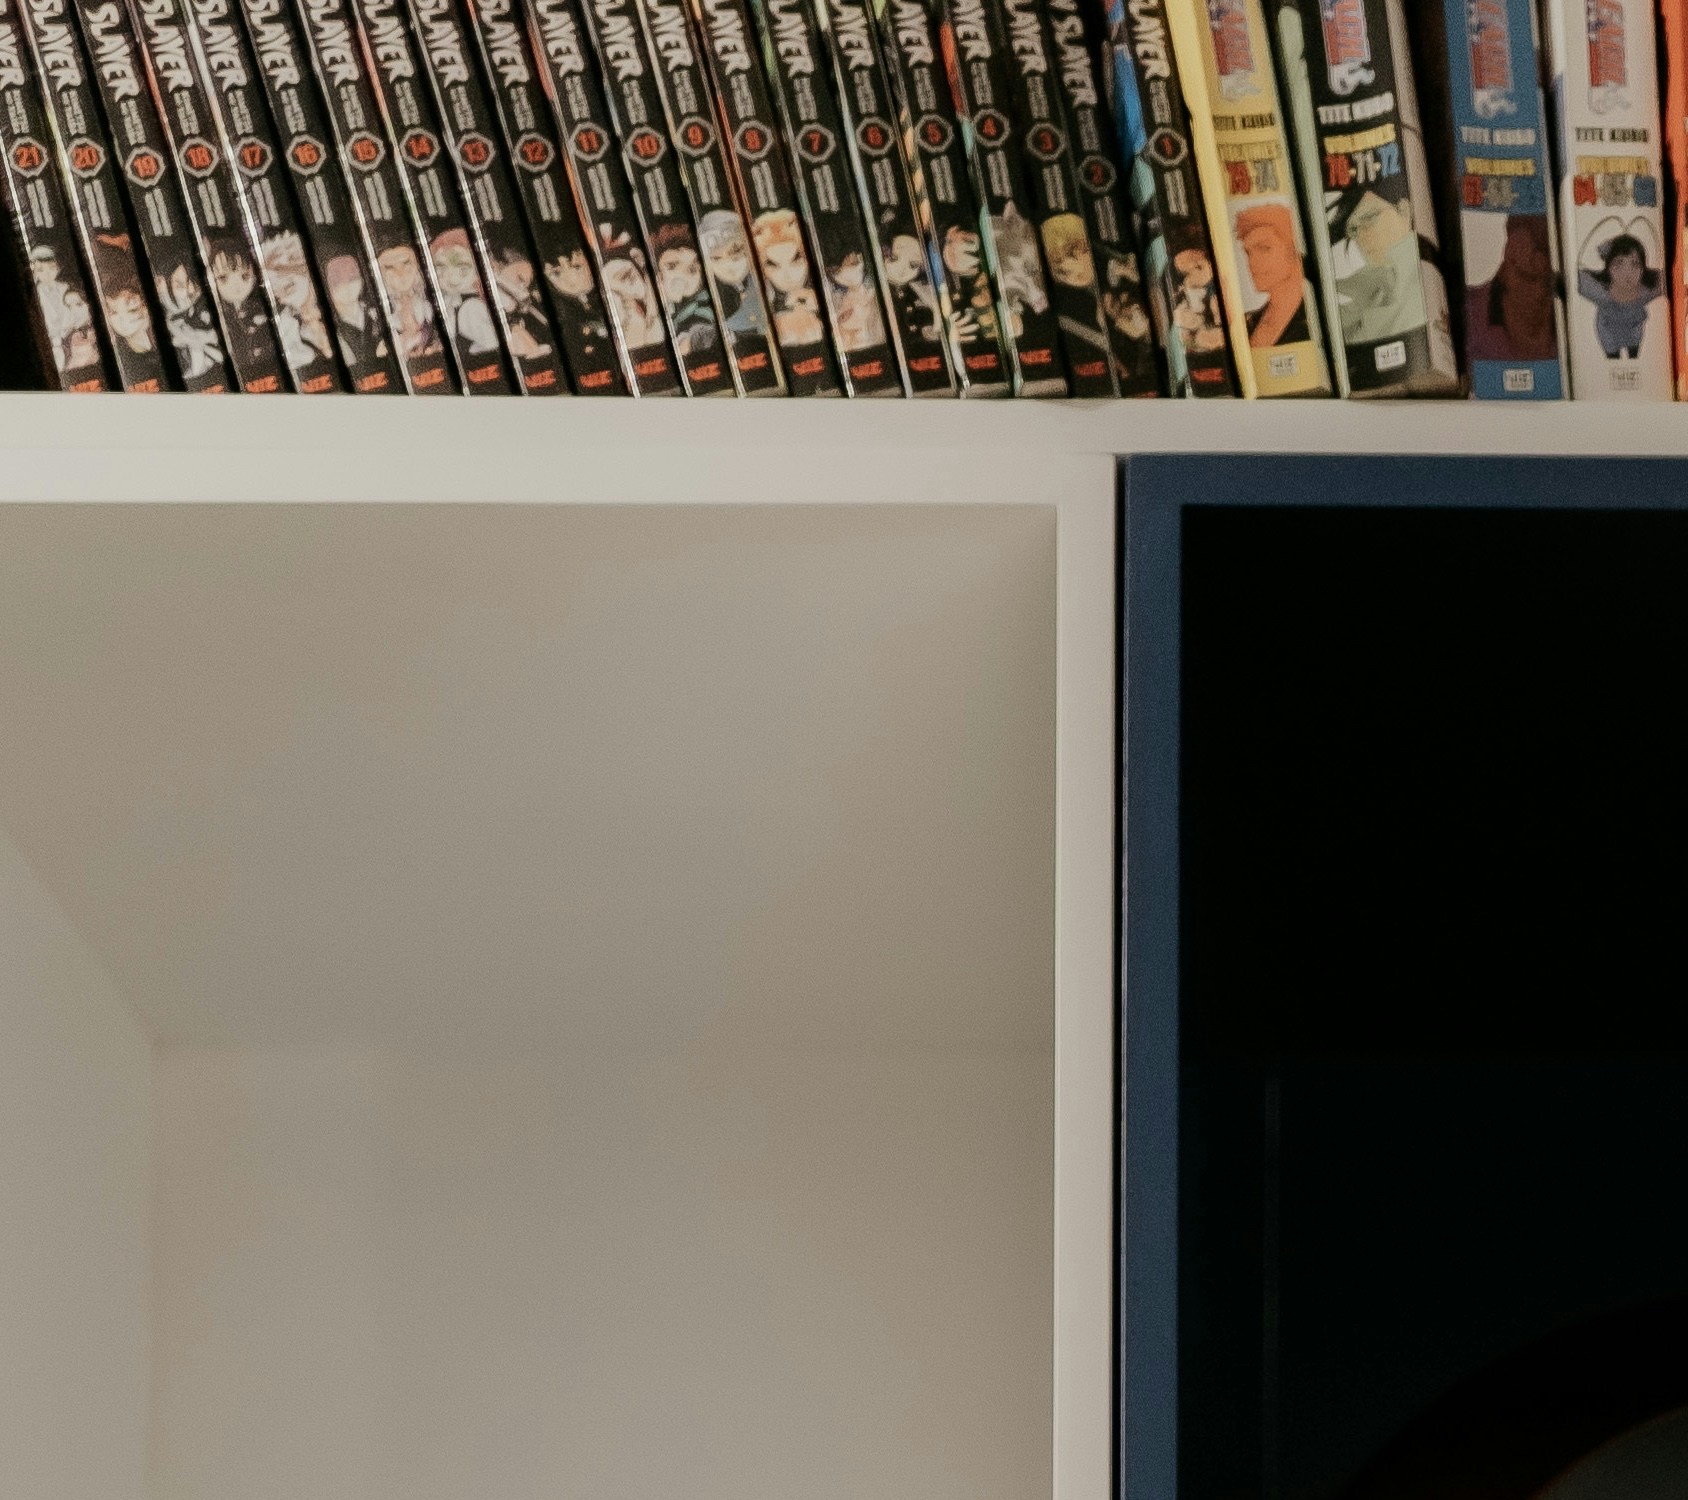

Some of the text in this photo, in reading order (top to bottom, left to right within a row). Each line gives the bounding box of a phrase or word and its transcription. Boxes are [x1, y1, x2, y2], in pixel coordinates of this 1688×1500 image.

[85, 3, 140, 103] SLAYER
[363, 0, 416, 84] LAYER
[535, 0, 585, 78] LAYER
[595, 0, 644, 82] LAYER
[646, 0, 694, 73] AYER
[768, 0, 815, 79] LAYER
[833, 0, 875, 71] AYER
[894, 0, 934, 68] AYER
[1051, 15, 1098, 108] SLAYER
[1128, 0, 1170, 80] LAYER
